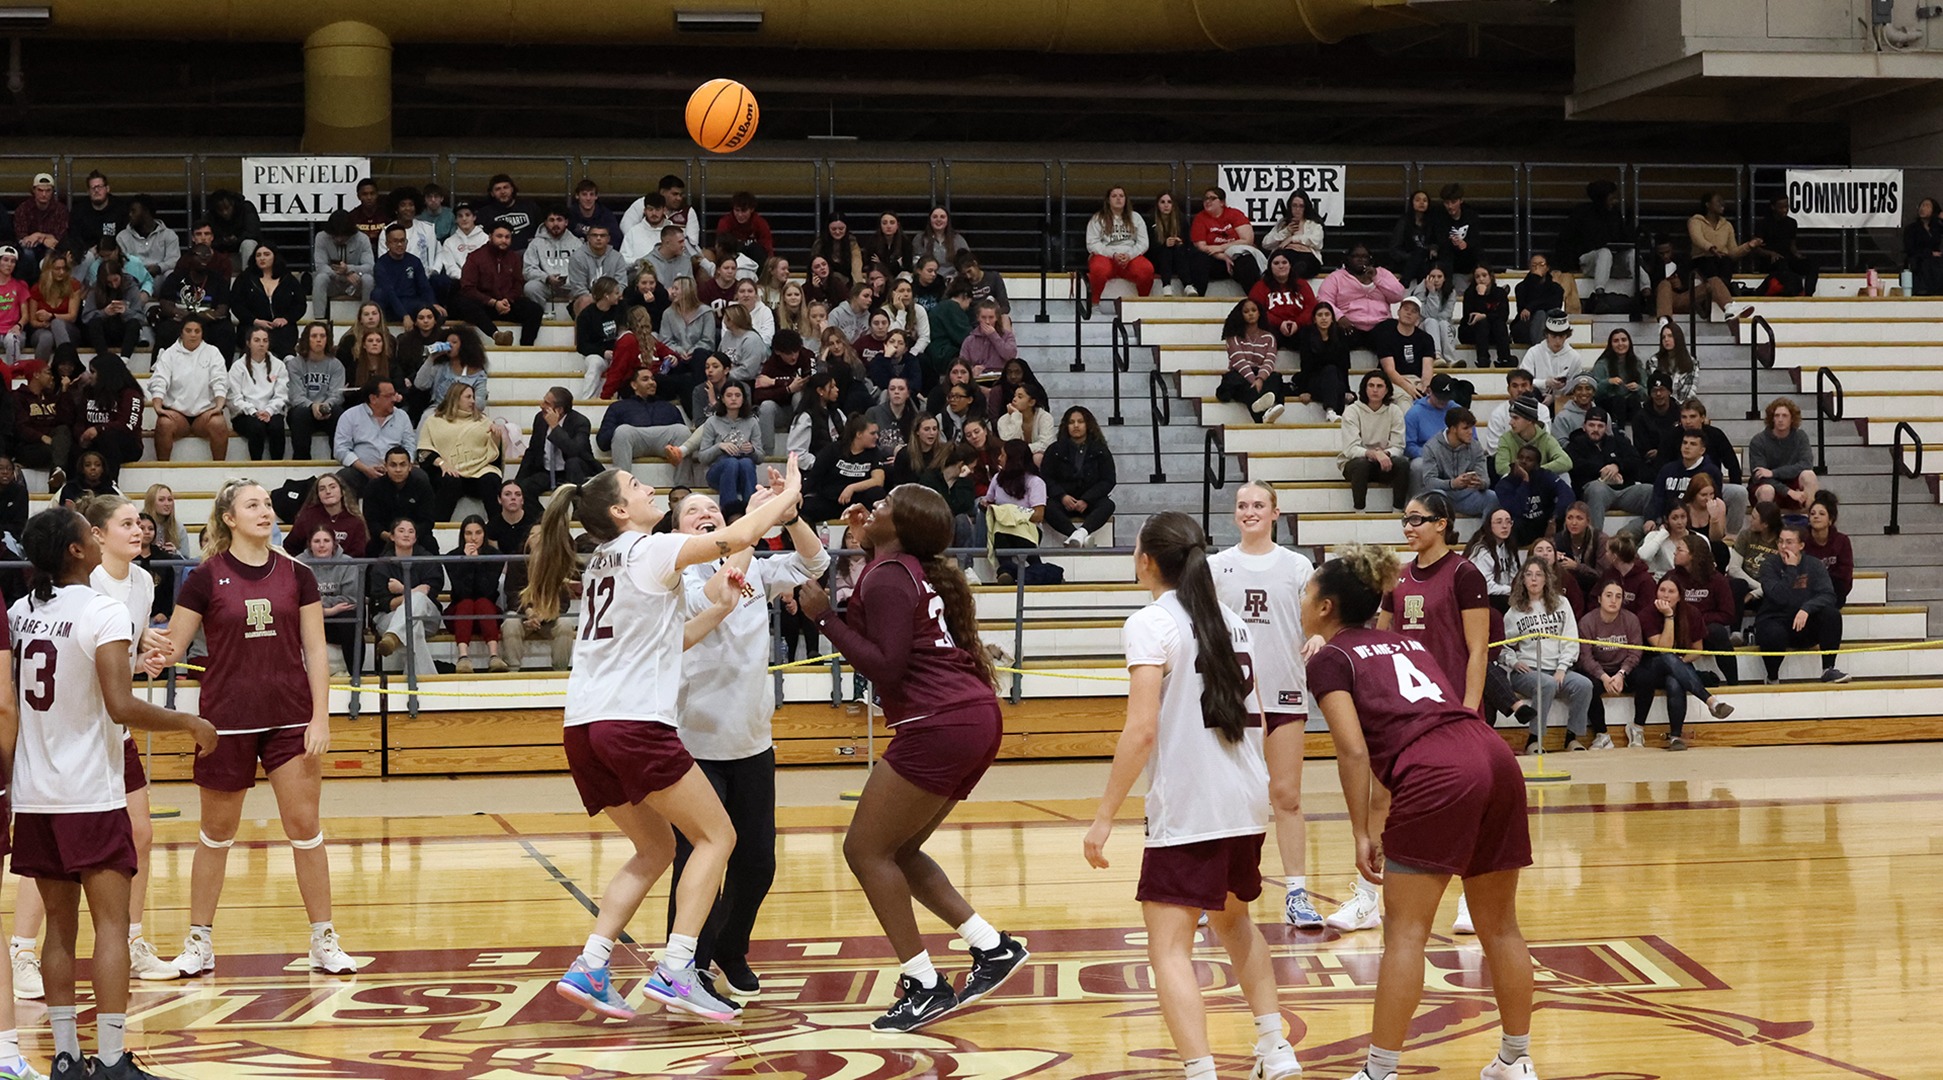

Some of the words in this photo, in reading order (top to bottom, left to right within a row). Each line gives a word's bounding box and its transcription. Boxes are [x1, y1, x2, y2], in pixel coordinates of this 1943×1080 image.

[725, 103, 754, 148] Wilson
[254, 165, 359, 184] PENFIELD
[1223, 168, 1340, 192] WEBER
[1789, 181, 1898, 214] COMMUTERS
[1245, 198, 1328, 223] HAL
[581, 575, 615, 641] 12
[20, 618, 42, 634] ARE
[49, 621, 57, 636] I
[56, 621, 73, 638] AM
[1516, 614, 1540, 634] RHODE
[1539, 609, 1566, 625] ISLAND
[1352, 645, 1374, 660] WE
[1371, 643, 1395, 656] ARE
[14, 638, 58, 712] 13
[1391, 652, 1447, 704] 4
